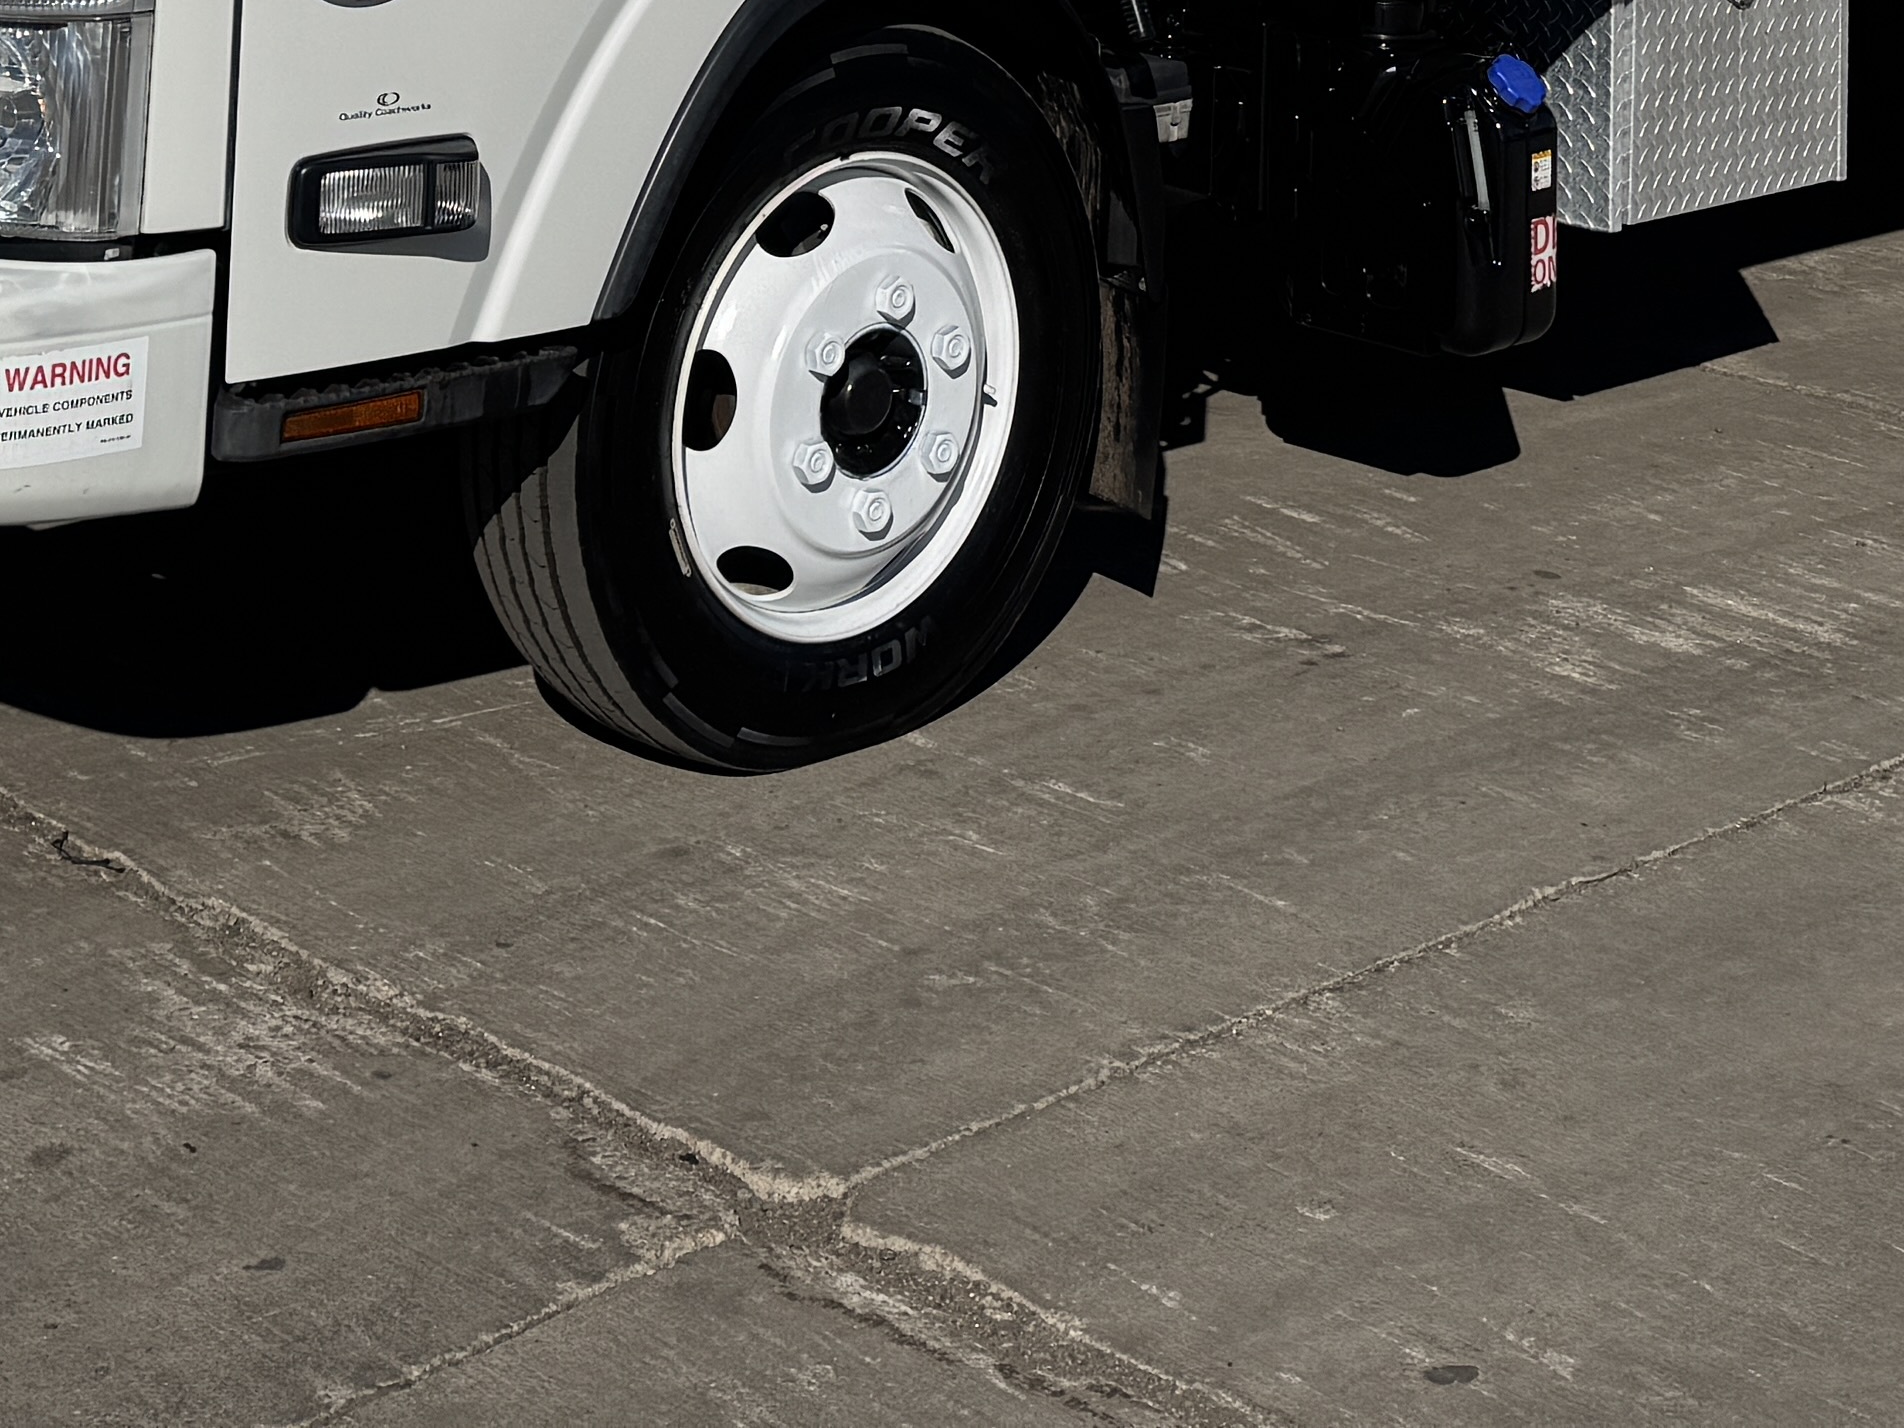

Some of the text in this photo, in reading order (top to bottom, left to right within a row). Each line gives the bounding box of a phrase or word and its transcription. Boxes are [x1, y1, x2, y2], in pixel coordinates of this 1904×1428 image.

[339, 110, 373, 121] Quality
[4, 352, 131, 393] WARNING
[52, 389, 133, 412] COMPONENTS
[85, 412, 134, 431] MARKED
